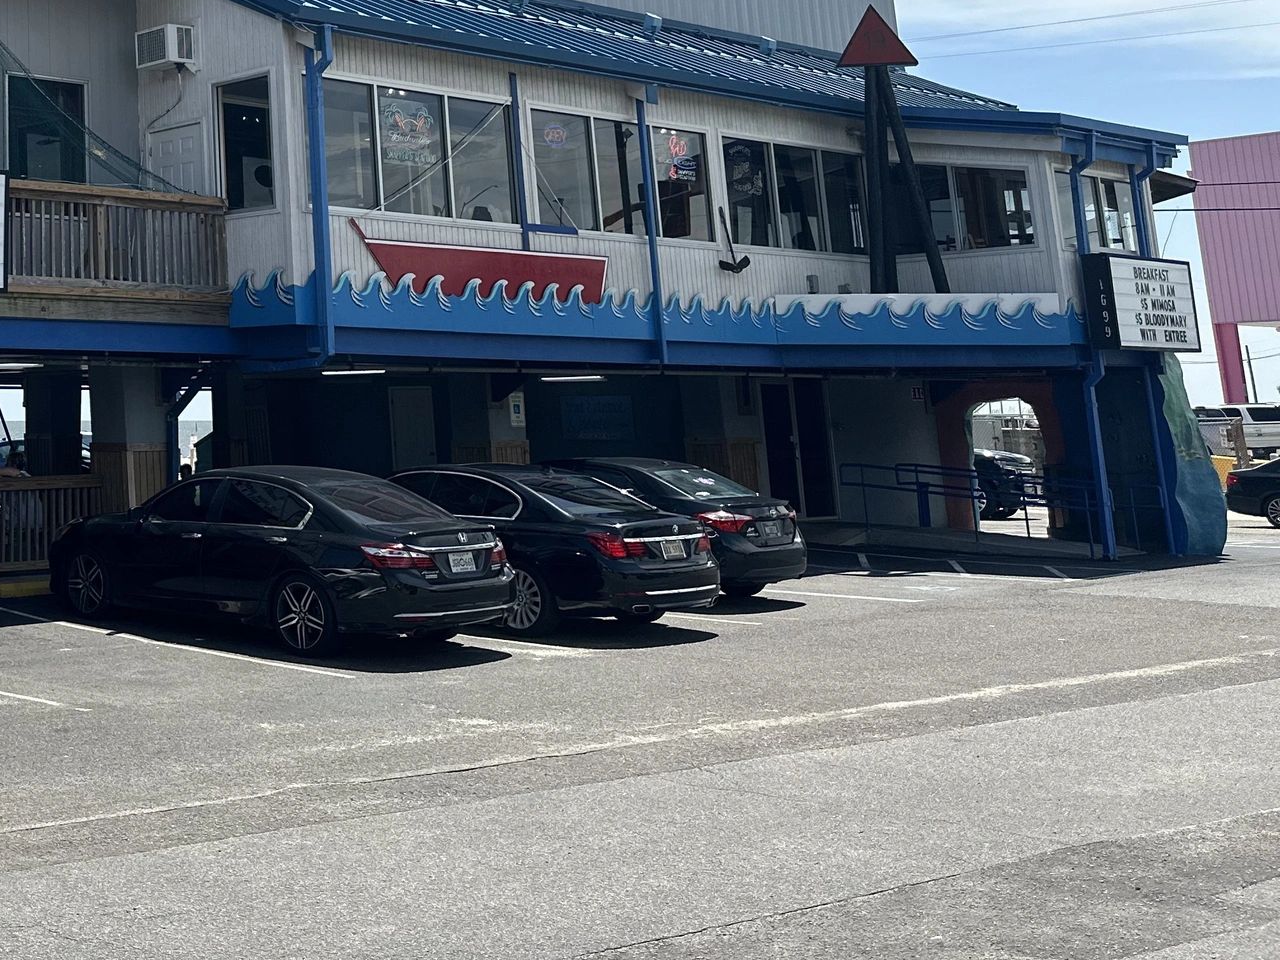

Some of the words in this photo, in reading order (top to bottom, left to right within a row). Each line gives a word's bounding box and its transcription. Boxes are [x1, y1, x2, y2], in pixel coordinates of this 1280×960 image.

[1133, 267, 1169, 282] BREAKFAST
[1140, 299, 1148, 310] $5
[1151, 298, 1177, 312] MIMOSA
[1135, 312, 1143, 325] $5
[1140, 328, 1158, 342] WITH
[1164, 329, 1188, 343] ENTREE
